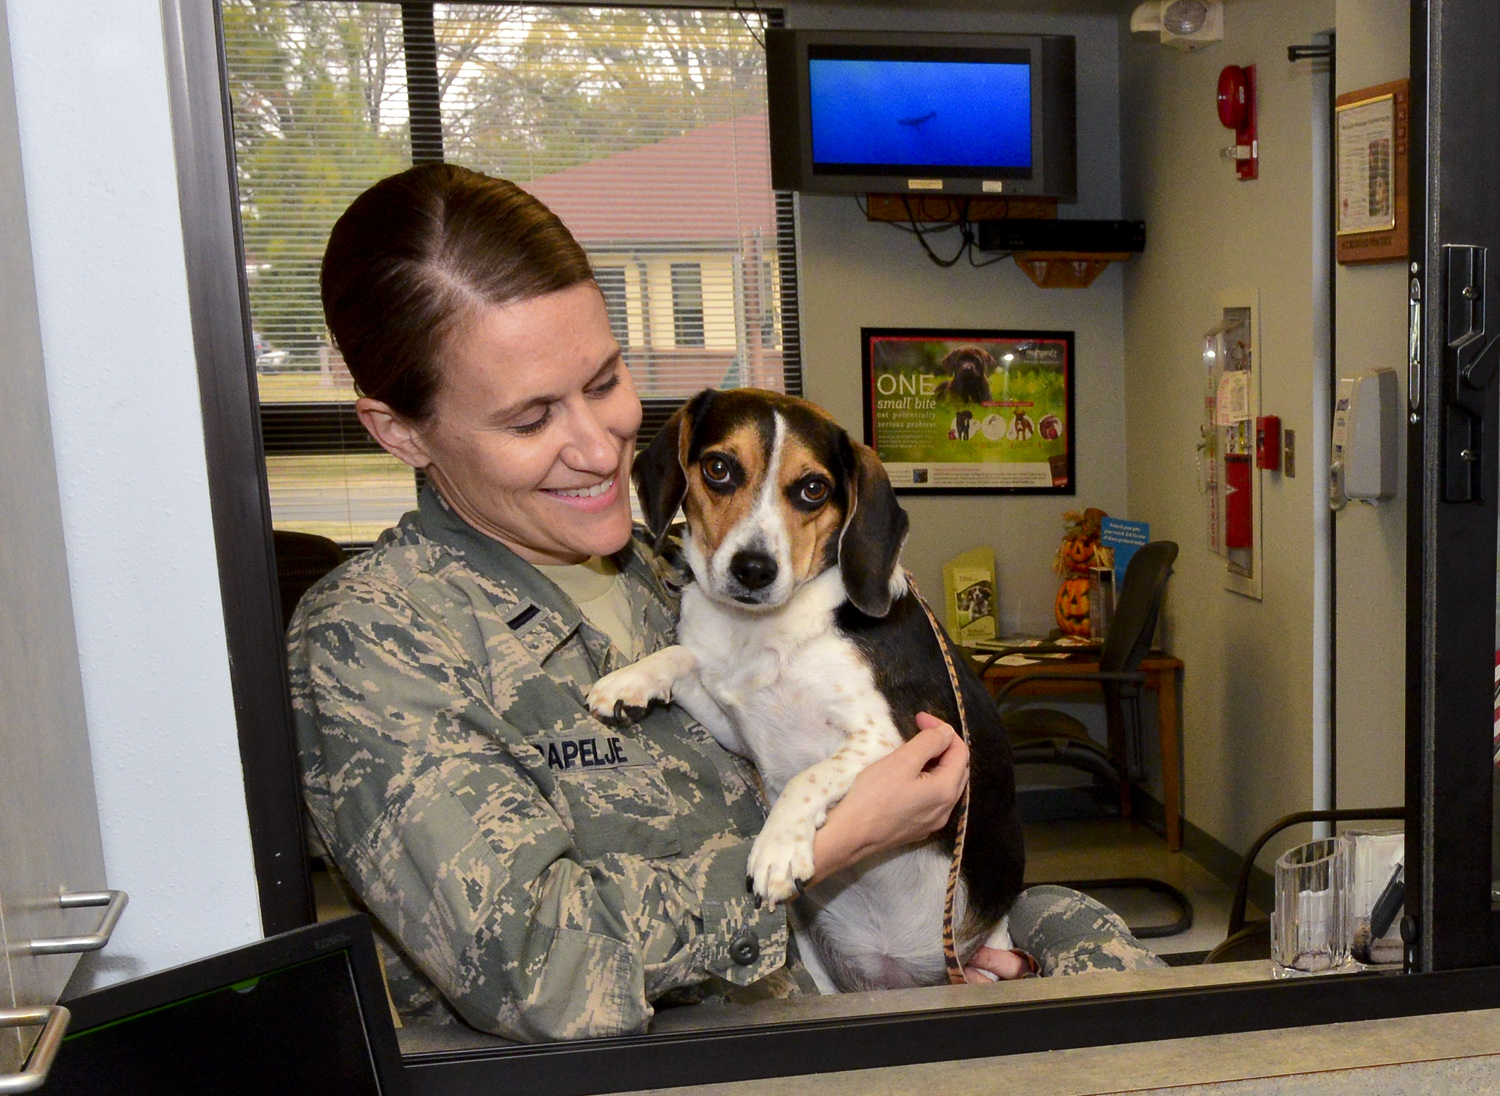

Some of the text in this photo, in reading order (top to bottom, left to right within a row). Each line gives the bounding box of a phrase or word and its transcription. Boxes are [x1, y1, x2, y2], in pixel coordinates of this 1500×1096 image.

[877, 373, 935, 396] ONE
[877, 396, 937, 410] small bite
